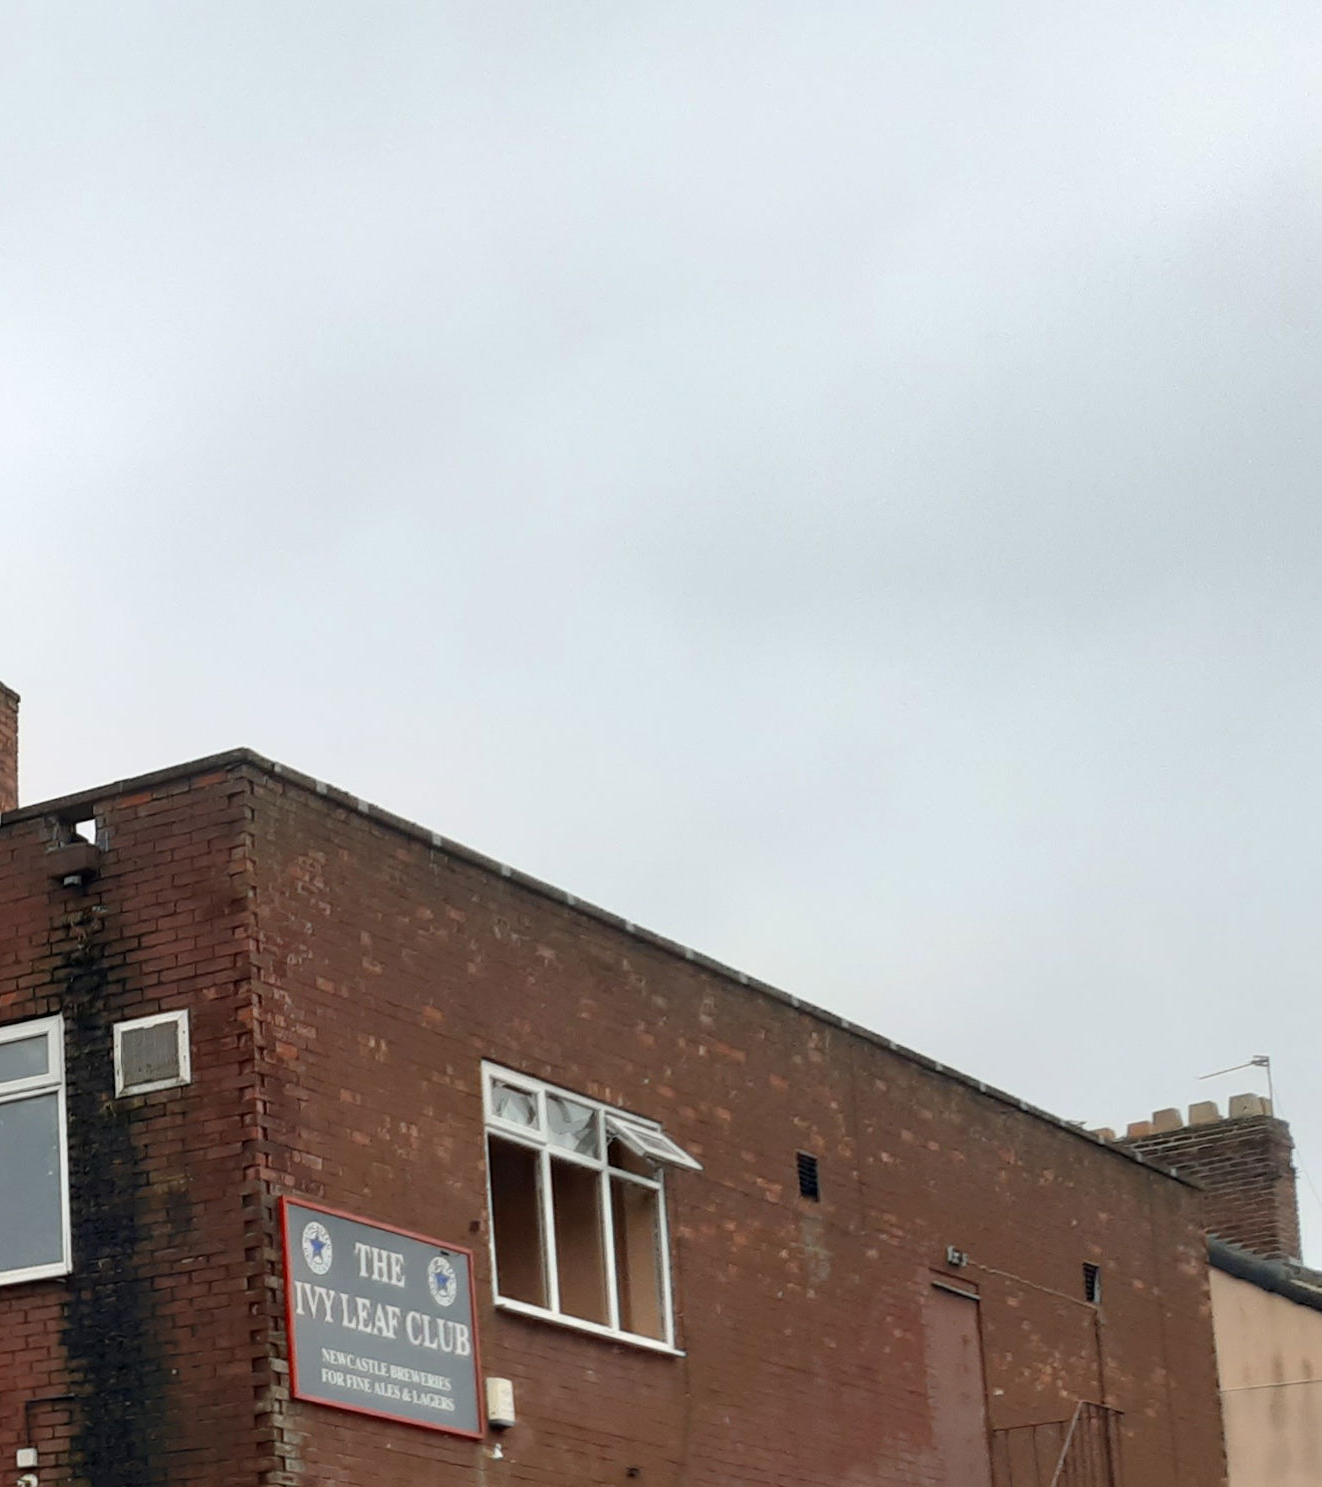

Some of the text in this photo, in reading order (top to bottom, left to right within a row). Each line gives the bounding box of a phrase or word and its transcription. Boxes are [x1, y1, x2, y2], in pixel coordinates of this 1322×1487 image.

[355, 1242, 405, 1288] THE
[294, 1280, 471, 1357] IVY LEAF CLUB
[321, 1347, 452, 1392] NEWCASTLE BREWERIES
[321, 1367, 455, 1412] FOR FINE ALES & LAGERS
